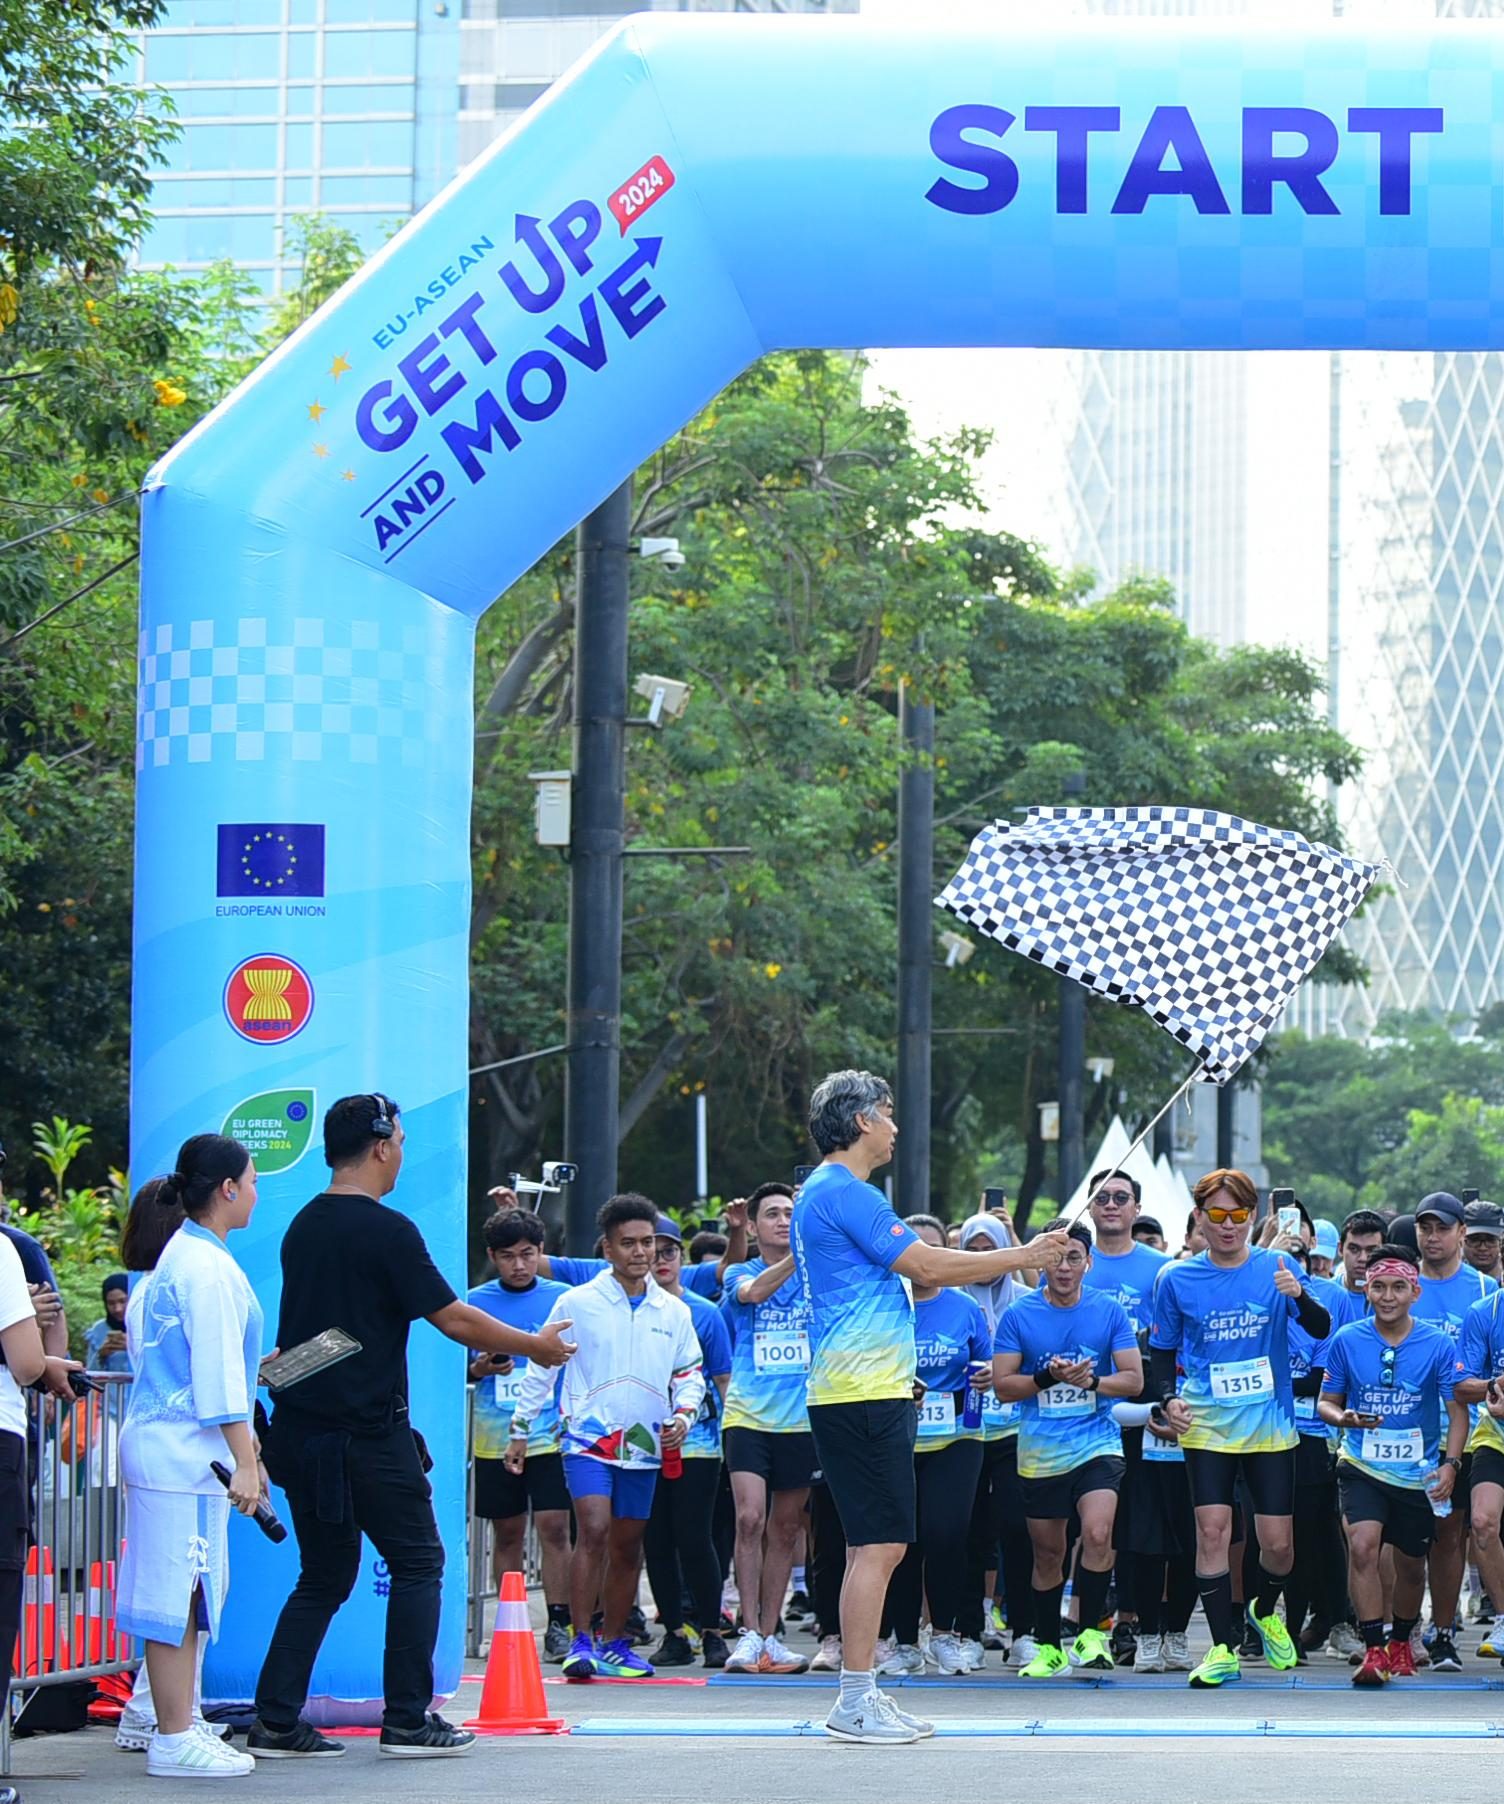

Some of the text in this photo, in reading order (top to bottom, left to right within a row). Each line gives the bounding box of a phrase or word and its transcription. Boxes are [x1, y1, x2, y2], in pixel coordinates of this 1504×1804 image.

[924, 103, 1443, 216] START
[618, 166, 665, 216] 2024
[371, 234, 496, 351] EU-ASEAN
[355, 199, 603, 453] GET UP
[372, 245, 668, 552] AND MOVE
[215, 904, 327, 918] EUROPEAN UNION
[243, 1021, 292, 1031] asean
[232, 1119, 283, 1128] EU GREEN
[232, 1129, 289, 1139] DIPLOMACY
[236, 1139, 293, 1150] EEKS 2024
[760, 1308, 785, 1322] GET
[1209, 1316, 1237, 1330] GET
[1239, 1311, 1259, 1327] UP
[766, 1319, 803, 1331] MOVE
[1218, 1327, 1260, 1341] MOVE
[760, 1345, 803, 1361] 1001
[918, 1355, 948, 1368] OVE
[1221, 1374, 1263, 1394] 1315
[1043, 1388, 1089, 1404] 1324
[1364, 1391, 1391, 1403] GET
[1391, 1390, 1412, 1404] UP
[918, 1406, 945, 1422] 313
[1371, 1403, 1412, 1416] MOVE
[1373, 1443, 1413, 1459] 1312
